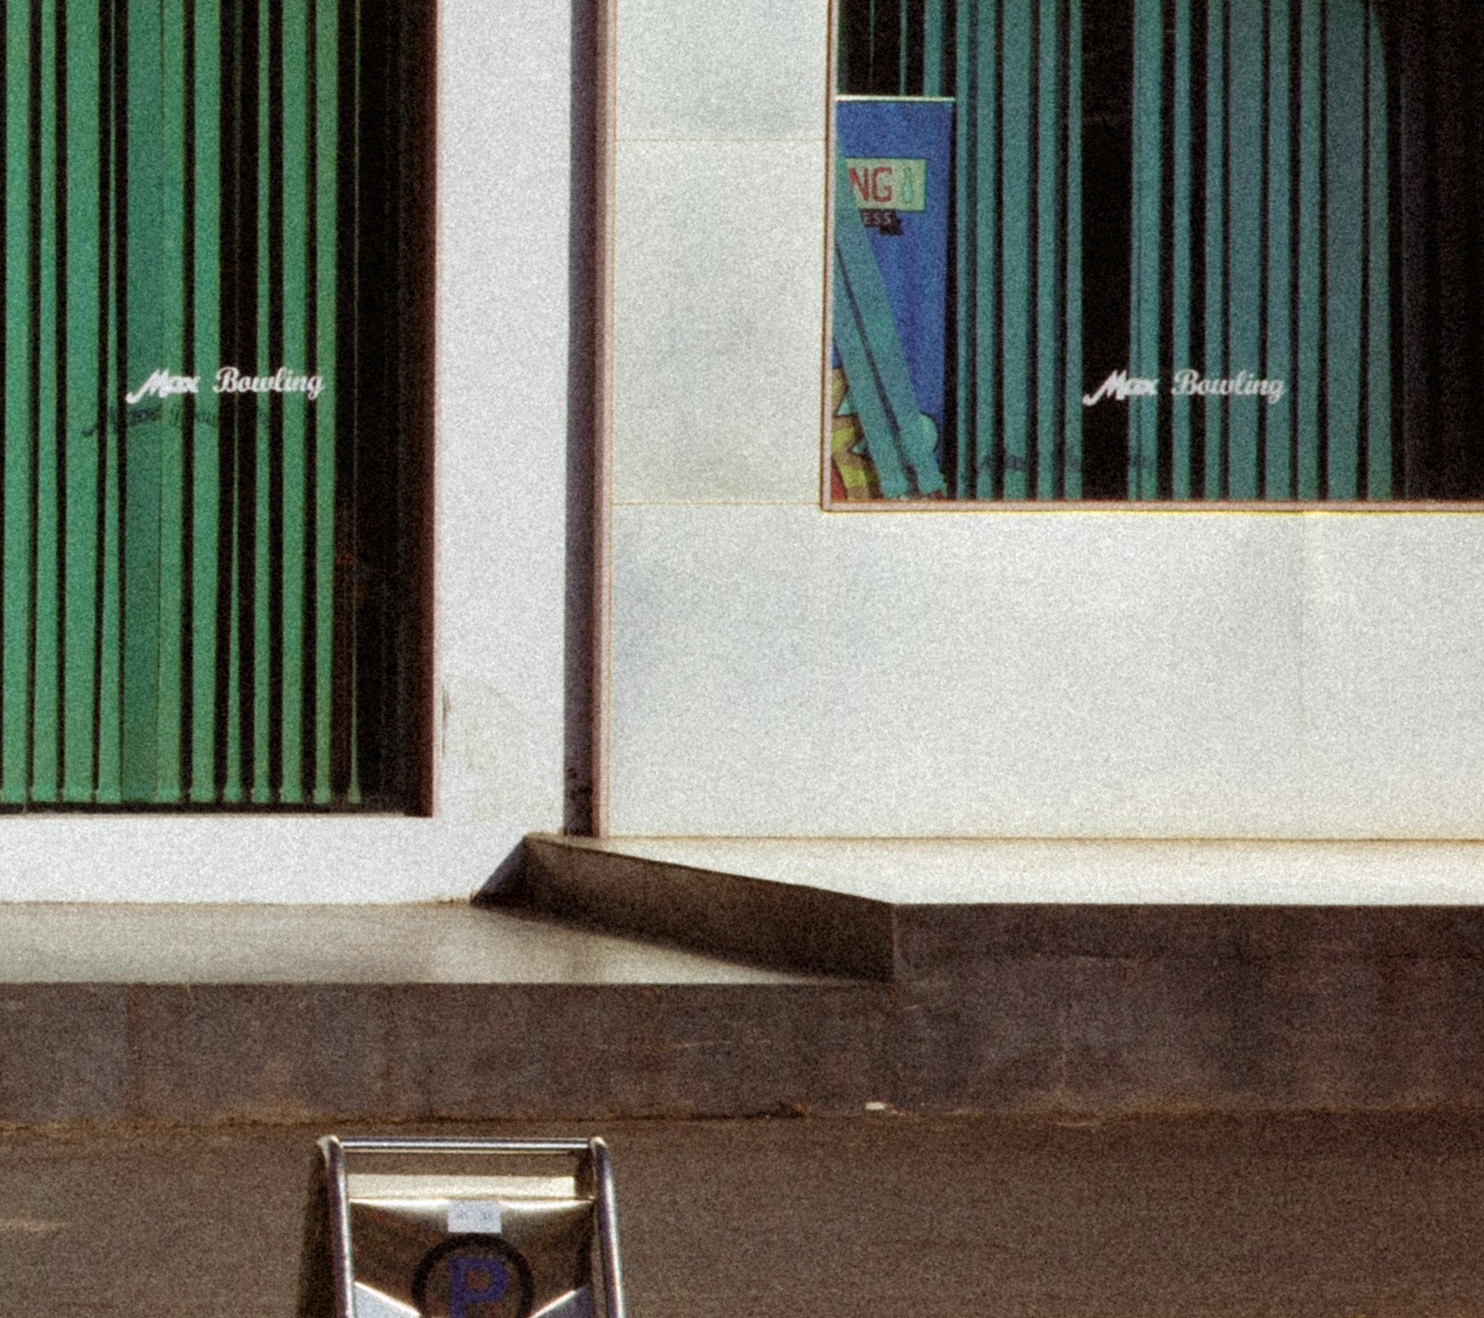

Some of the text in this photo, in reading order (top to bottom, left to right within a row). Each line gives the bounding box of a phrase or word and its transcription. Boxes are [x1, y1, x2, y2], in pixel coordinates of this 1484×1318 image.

[126, 367, 324, 403] Max Bowling
[1082, 369, 1287, 407] Max Bowling
